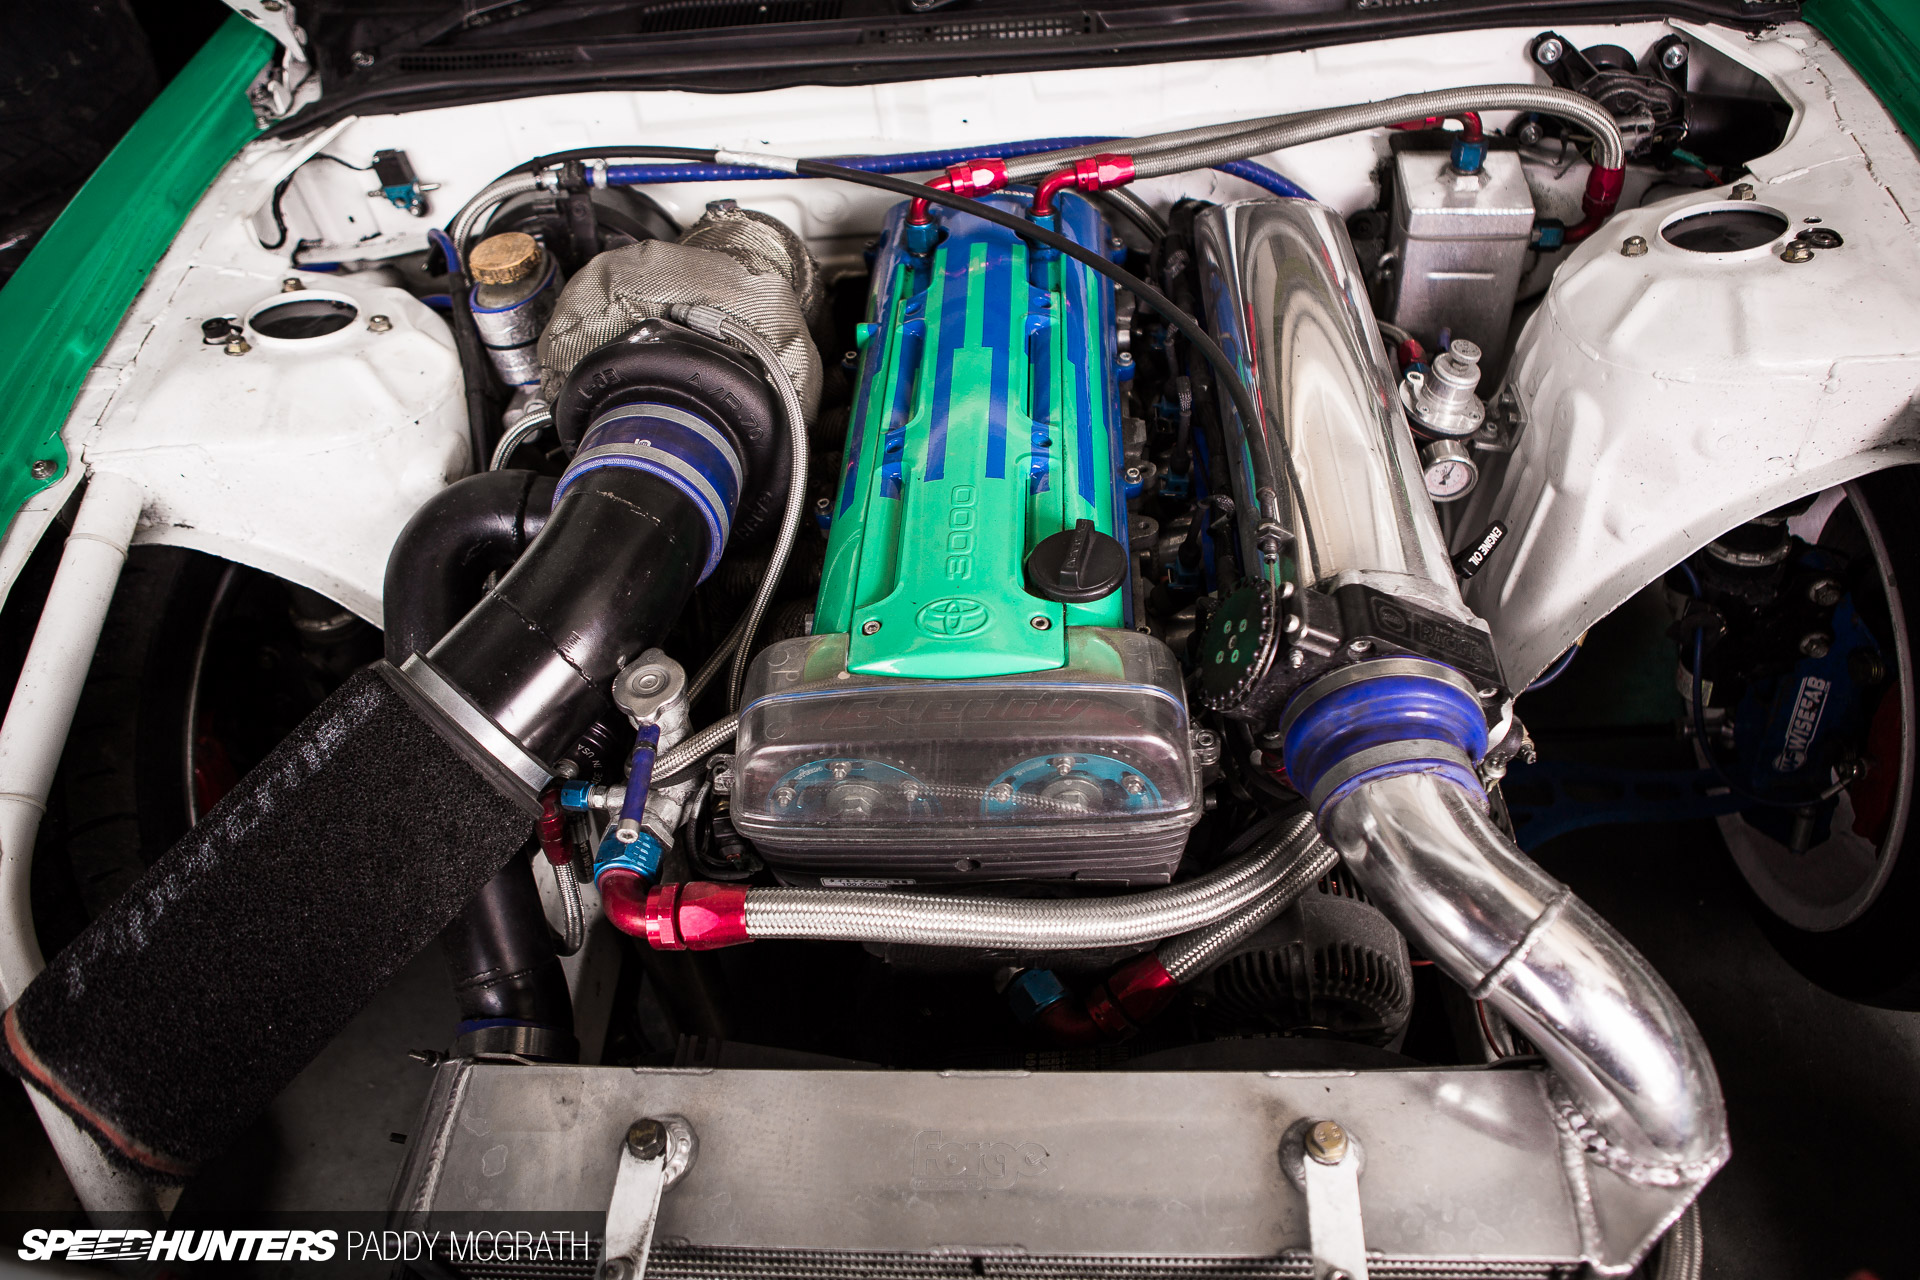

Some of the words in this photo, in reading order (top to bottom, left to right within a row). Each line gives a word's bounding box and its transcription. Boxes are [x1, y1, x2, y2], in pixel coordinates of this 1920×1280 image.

[945, 484, 977, 580] 3000
[1477, 526, 1503, 556] ENGINE
[1468, 551, 1484, 566] OIL
[576, 743, 596, 760] USA
